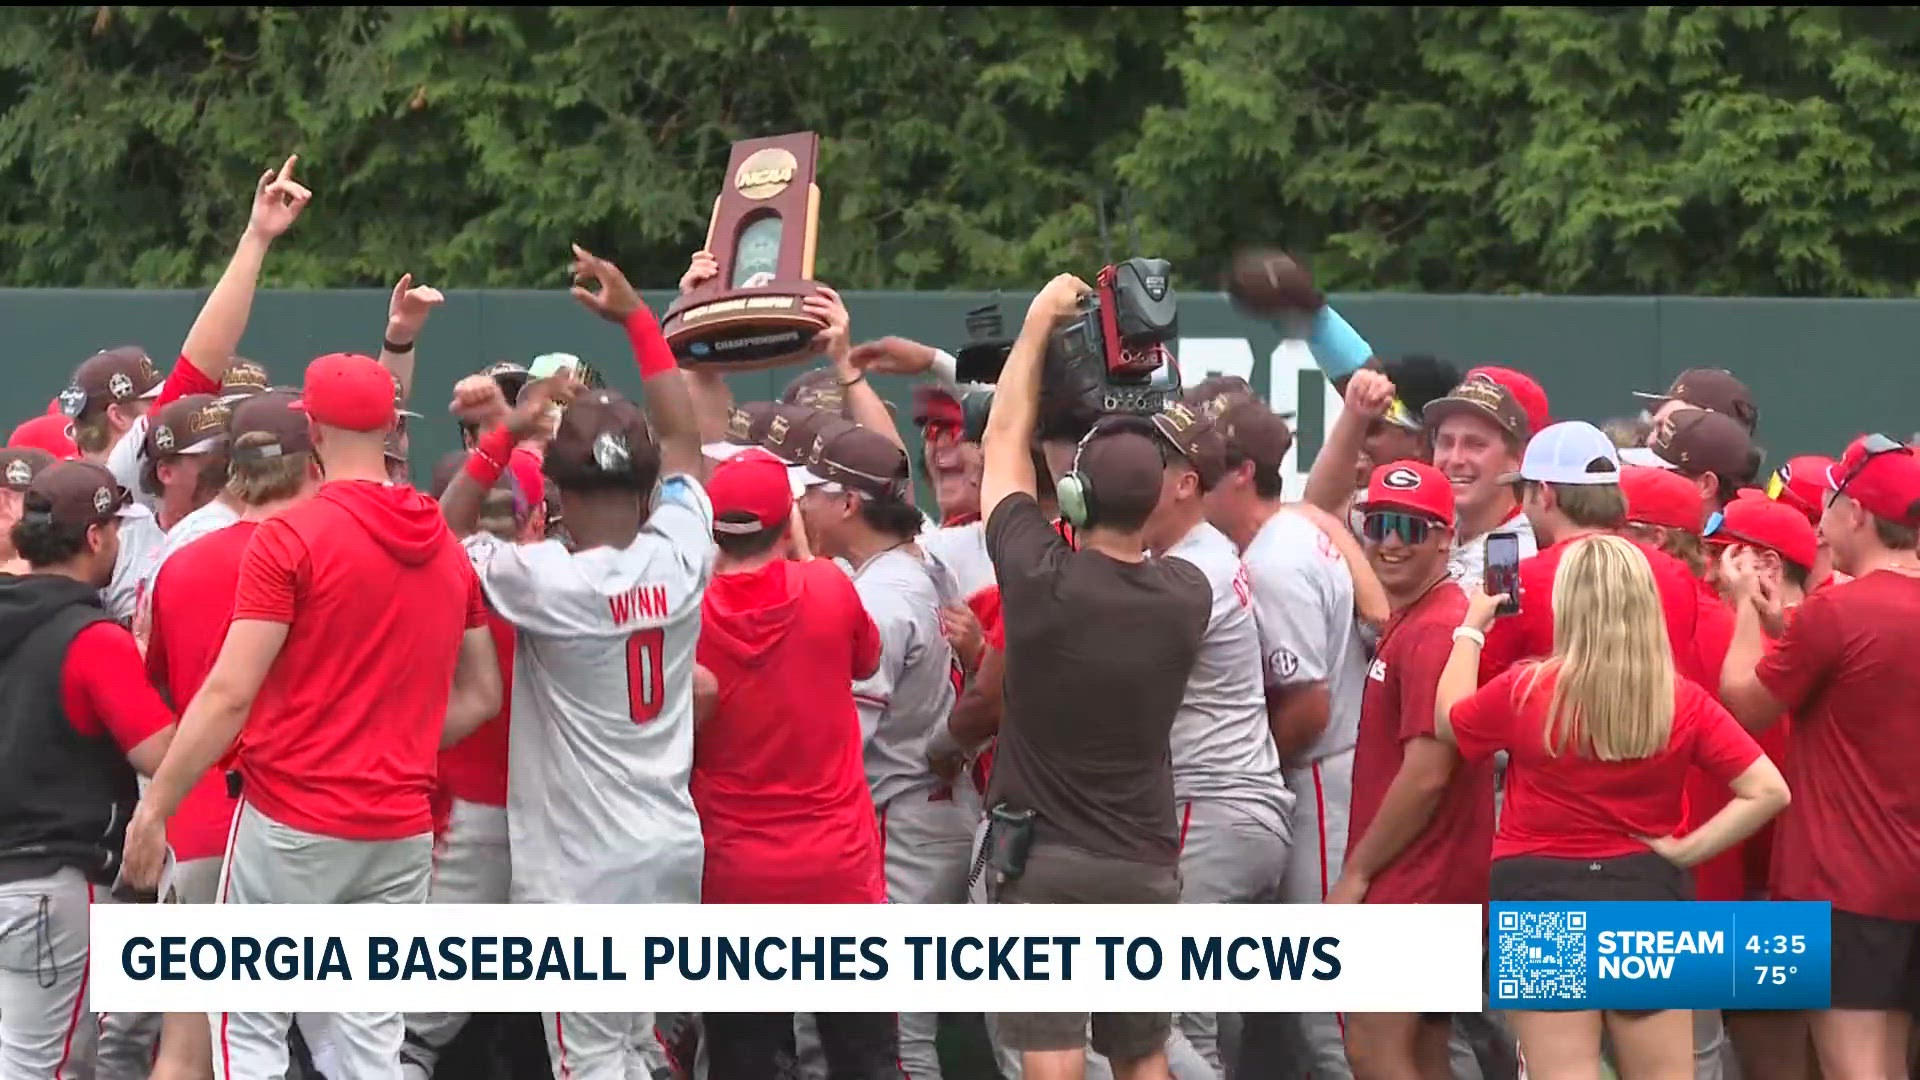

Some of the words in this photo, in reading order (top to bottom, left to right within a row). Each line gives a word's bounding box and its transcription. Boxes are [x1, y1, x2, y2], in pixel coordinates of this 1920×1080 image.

[1382, 467, 1421, 490] G
[609, 583, 668, 625] WYNN
[626, 626, 664, 725] 0
